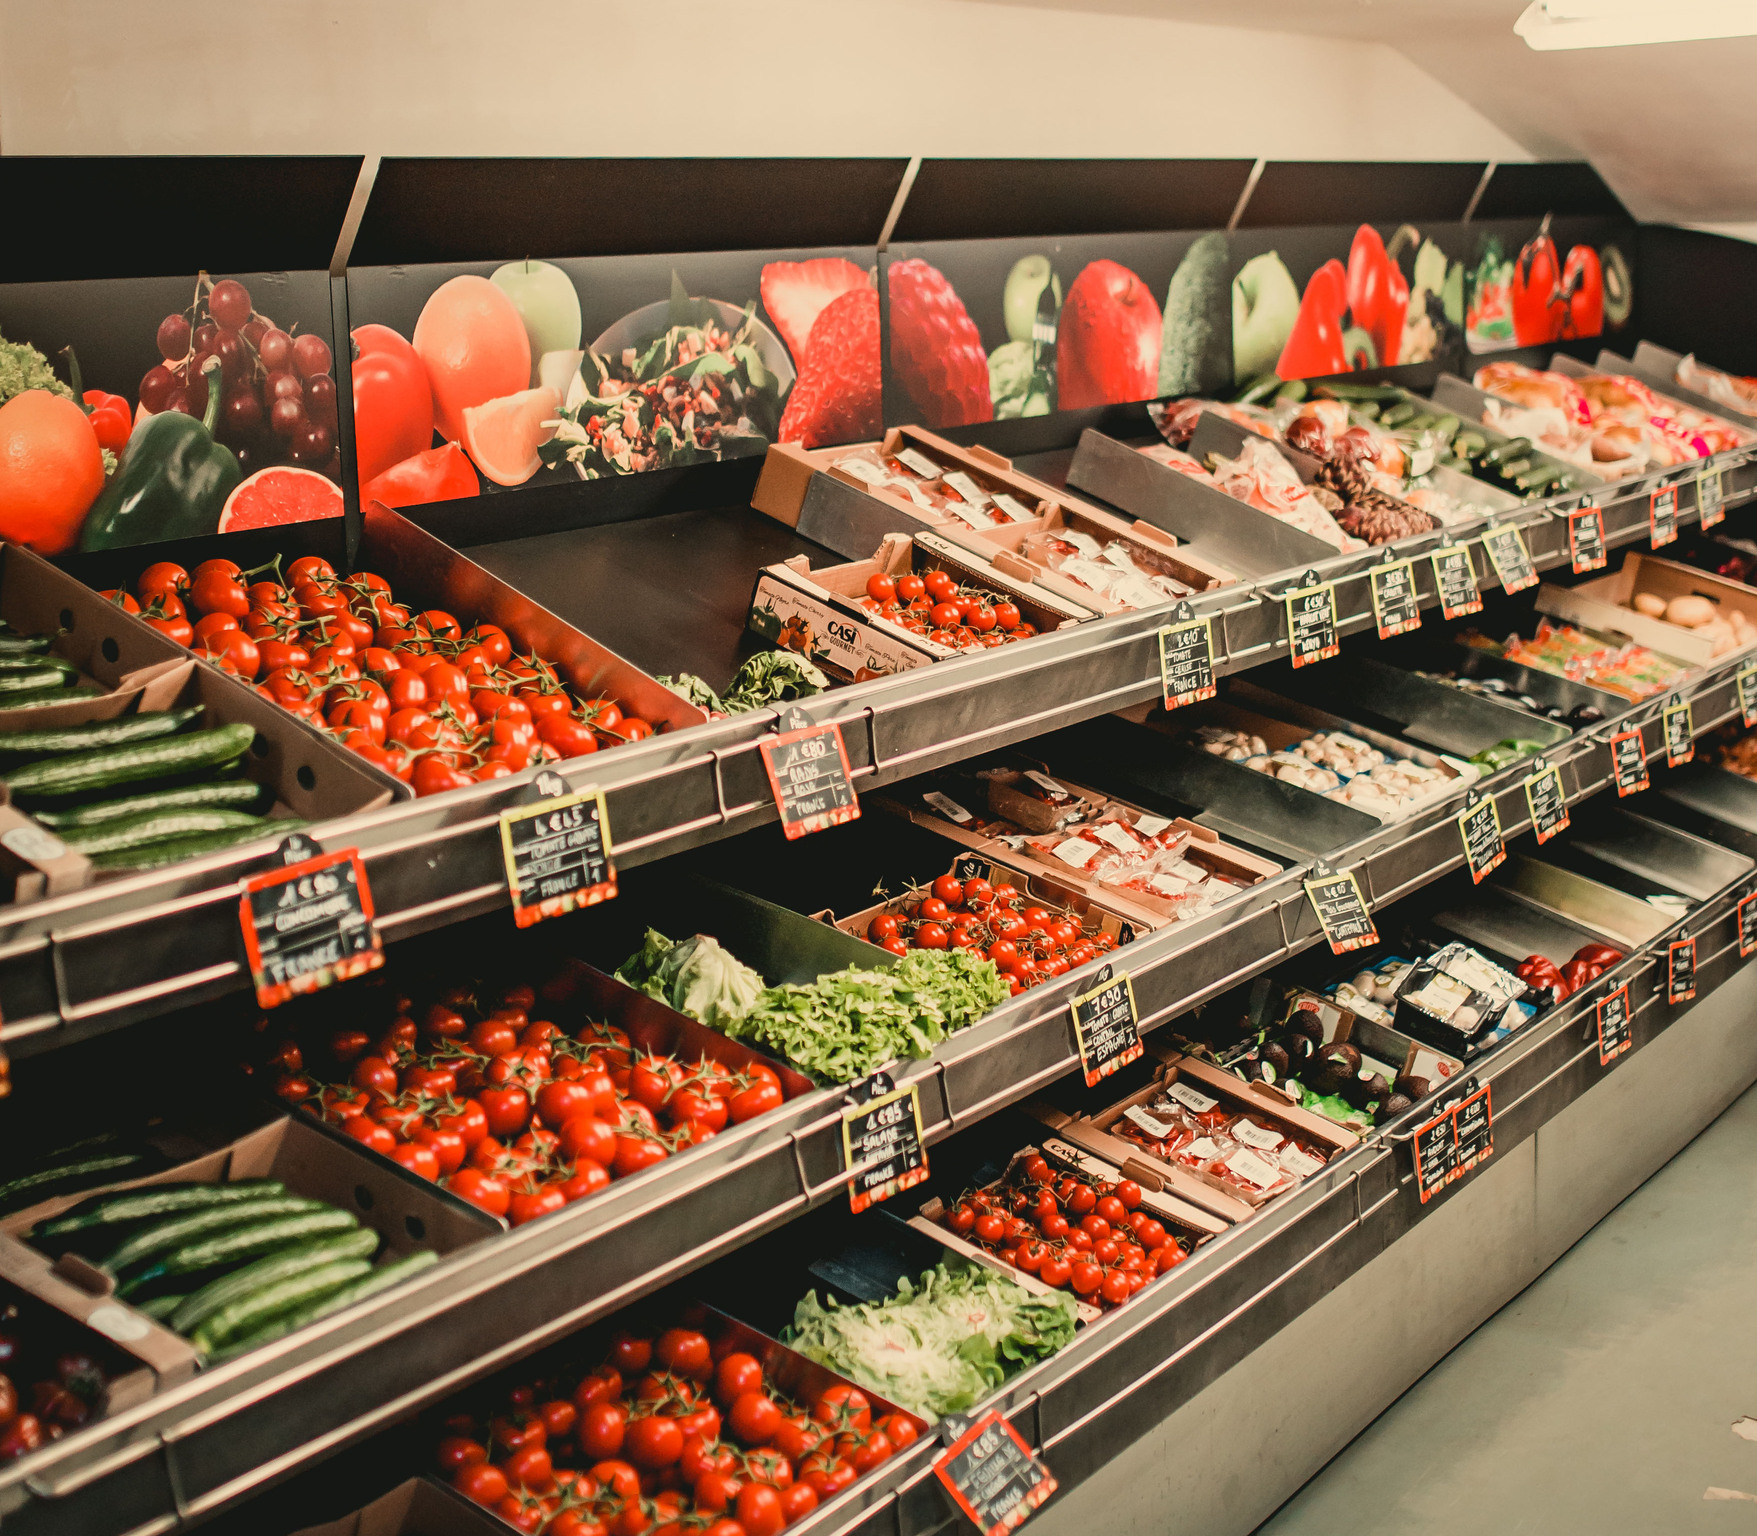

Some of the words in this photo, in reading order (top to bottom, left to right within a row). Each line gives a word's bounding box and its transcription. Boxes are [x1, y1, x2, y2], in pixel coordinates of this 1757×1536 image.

[828, 621, 857, 644] CASI
[829, 636, 856, 655] GOURMET
[1173, 649, 1191, 662] TOMATE
[1173, 675, 1197, 693] FRANCE
[789, 763, 819, 782] RADIS
[796, 797, 826, 816] FRANCE
[530, 835, 567, 860] TOMATE
[540, 870, 579, 897] FRANCE
[1096, 1031, 1126, 1062] ESPAGNE
[1127, 1032, 1136, 1046] 1
[864, 1163, 894, 1188] FRANCE
